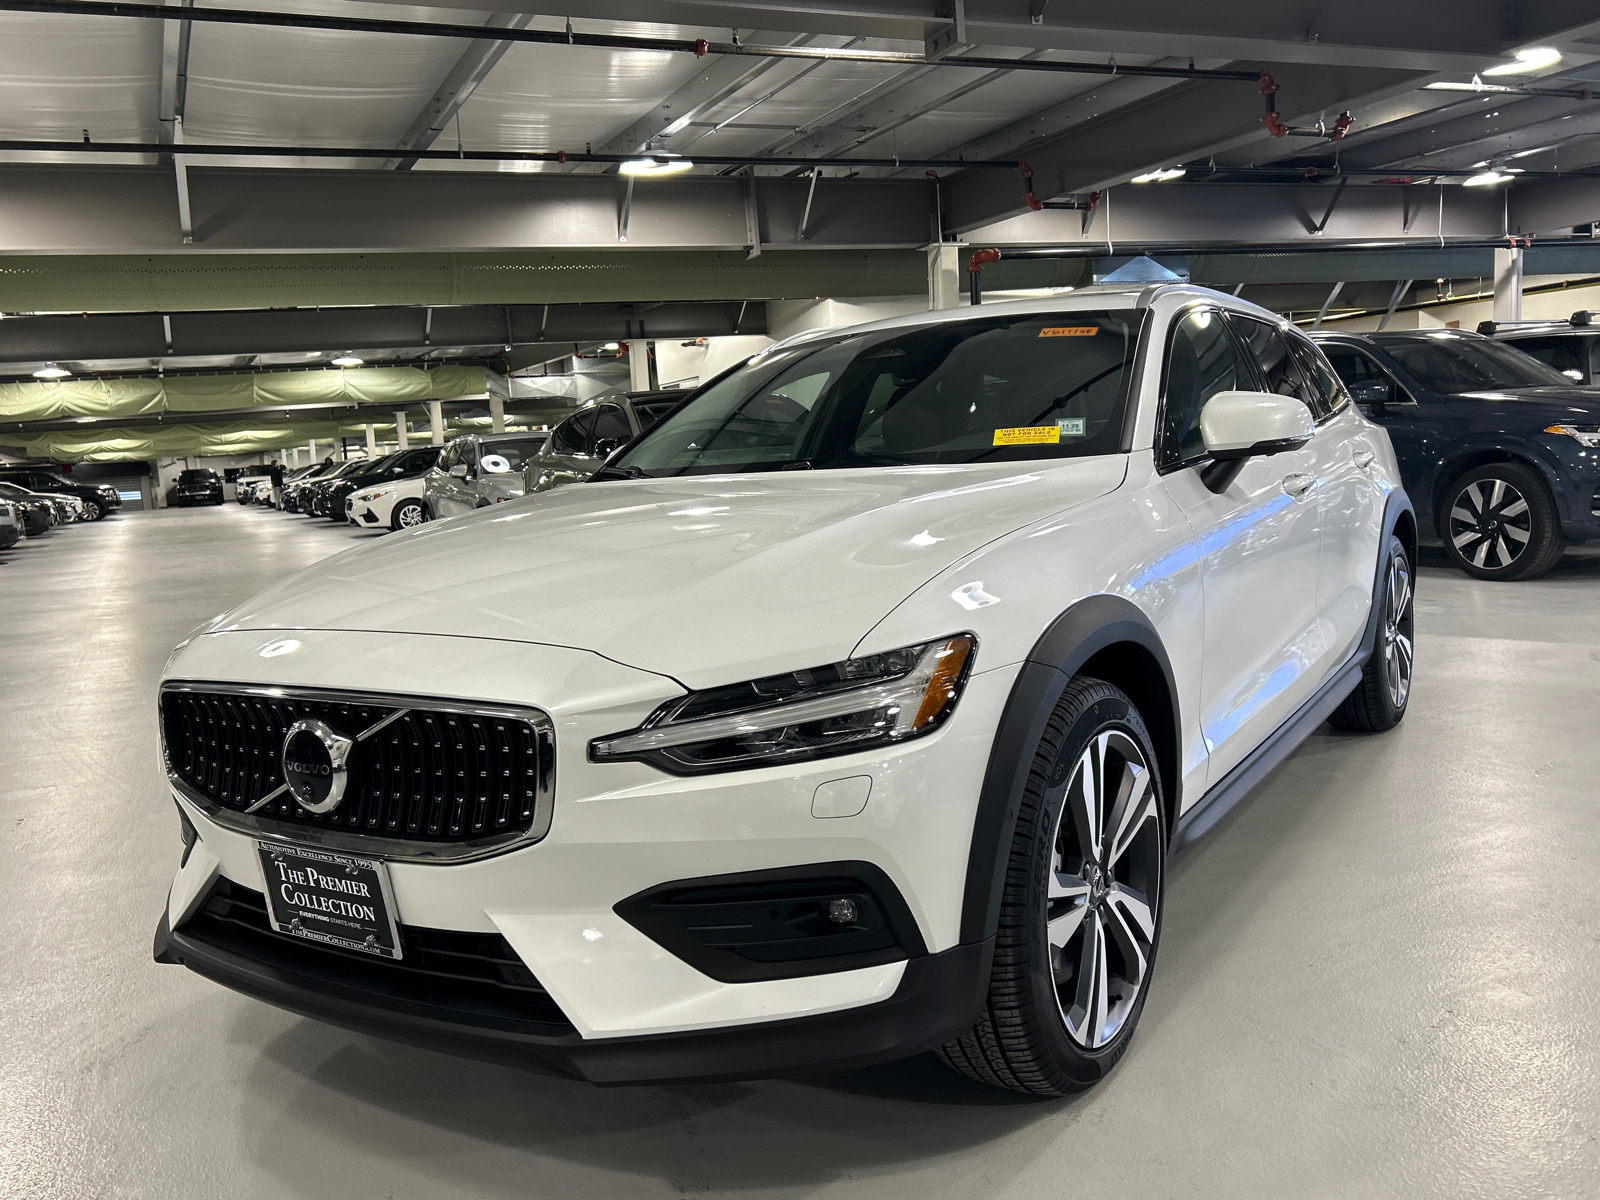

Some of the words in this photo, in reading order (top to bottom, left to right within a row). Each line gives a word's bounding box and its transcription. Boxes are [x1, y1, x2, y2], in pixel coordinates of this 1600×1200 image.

[286, 760, 330, 775] VOLVO
[260, 842, 296, 856] AUTOMOTIVE
[297, 848, 334, 862] EXCELLENCE
[354, 859, 372, 869] 1995
[275, 861, 307, 886] THE
[305, 867, 371, 898] PREMIER
[281, 883, 376, 922] COLLECTION
